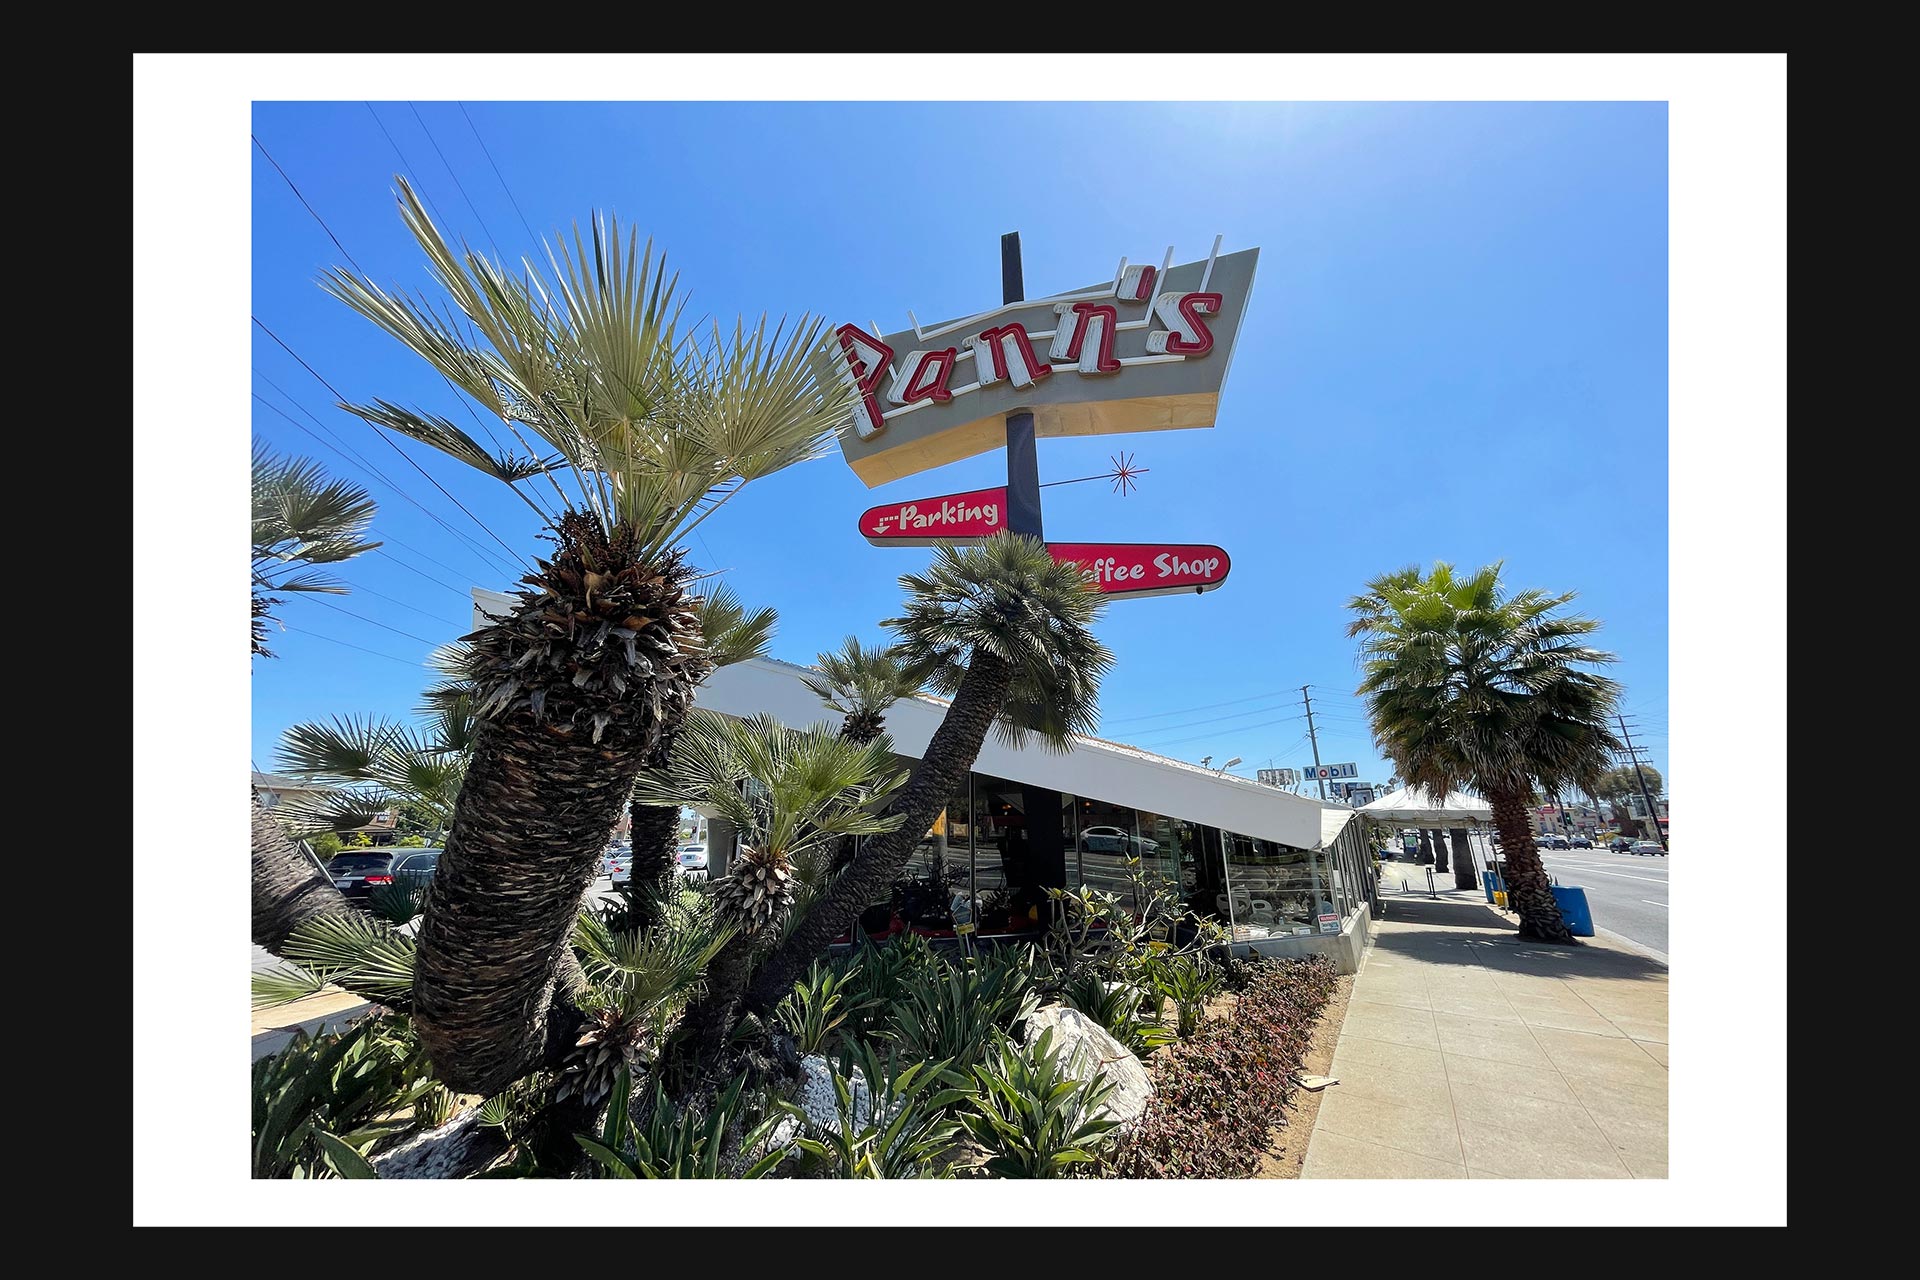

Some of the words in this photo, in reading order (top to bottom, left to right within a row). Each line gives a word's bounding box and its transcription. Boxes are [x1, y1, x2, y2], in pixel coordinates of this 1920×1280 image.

[828, 264, 1223, 439] Pann's
[899, 501, 999, 530] Parking
[1153, 552, 1219, 578] Shop
[1305, 764, 1355, 779] Mobil
